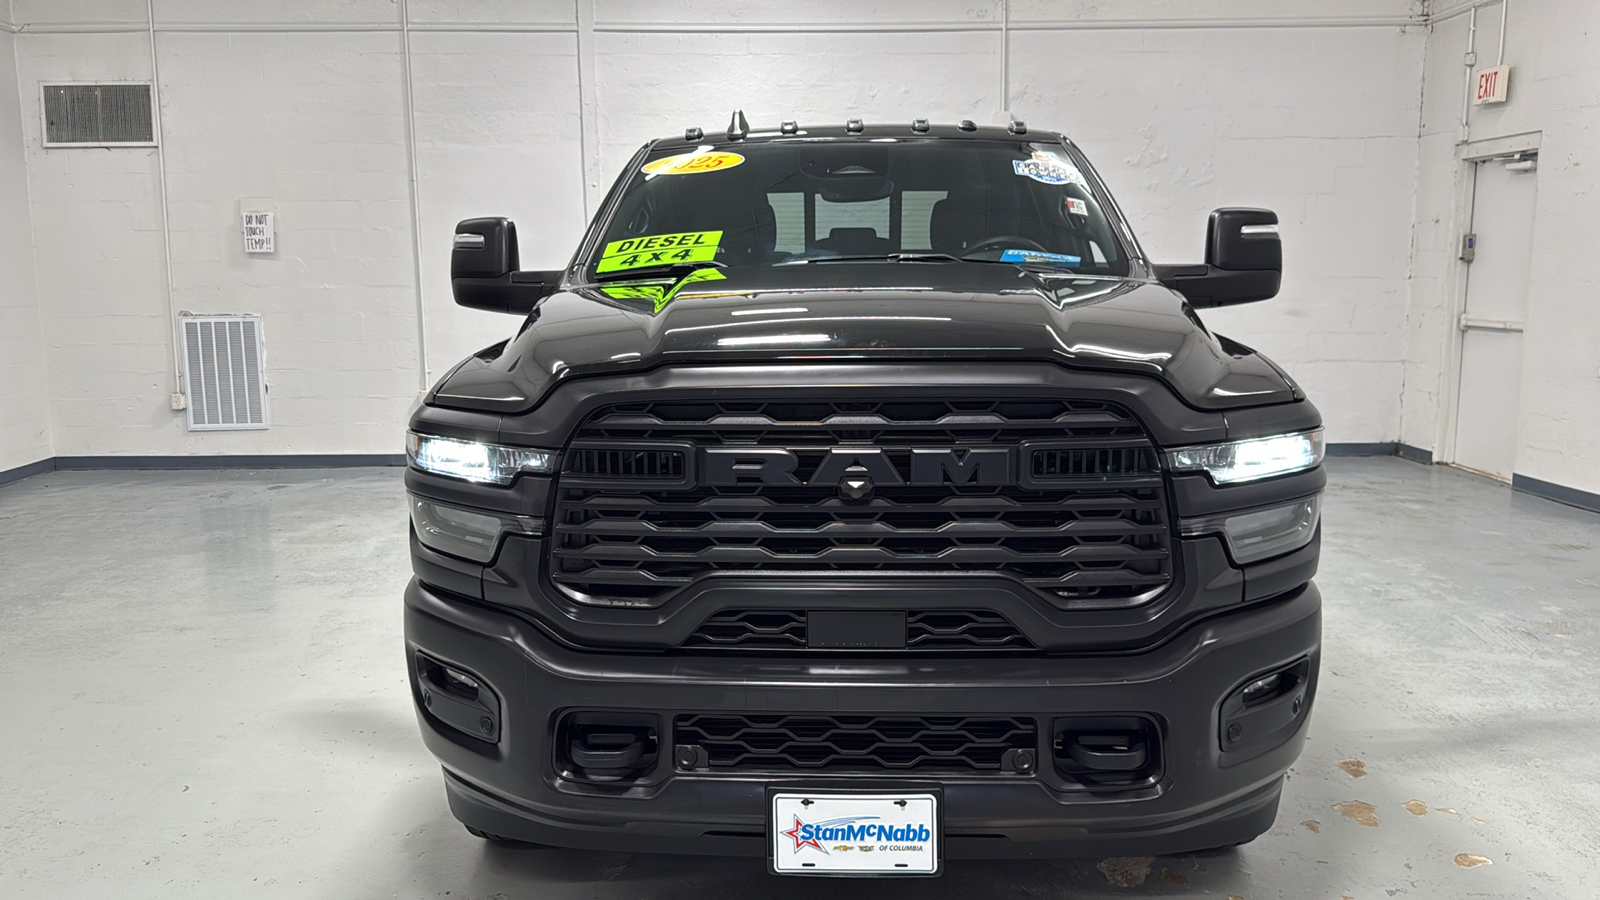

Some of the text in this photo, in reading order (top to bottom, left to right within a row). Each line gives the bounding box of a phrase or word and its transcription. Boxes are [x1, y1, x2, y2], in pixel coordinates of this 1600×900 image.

[1477, 71, 1499, 100] EXIT
[658, 154, 731, 170] 025
[245, 213, 269, 226] DO NOT
[245, 226, 265, 237] TOUCH
[246, 237, 272, 250] TEMP!!
[615, 233, 706, 253] DIESEL
[705, 448, 1010, 486] RAM
[878, 844, 924, 852] OF COLUMBIA
